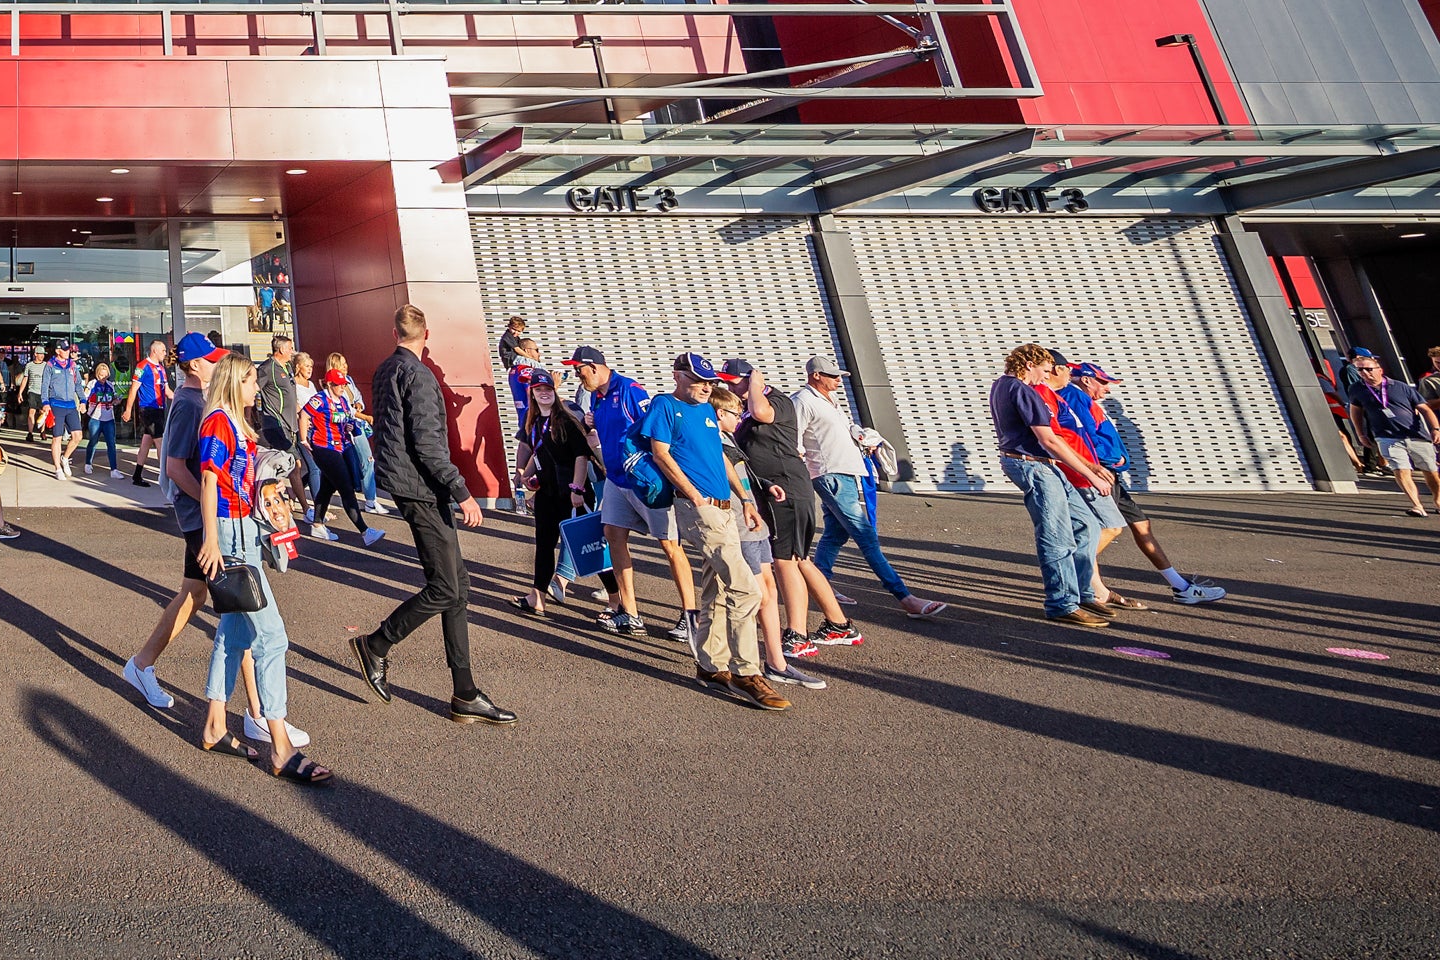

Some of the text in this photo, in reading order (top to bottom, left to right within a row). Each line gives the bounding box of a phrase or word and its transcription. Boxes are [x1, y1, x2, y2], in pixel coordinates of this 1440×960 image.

[565, 185, 679, 213] GATE 3
[972, 186, 1089, 213] GATE 3
[580, 541, 602, 555] ANZ
